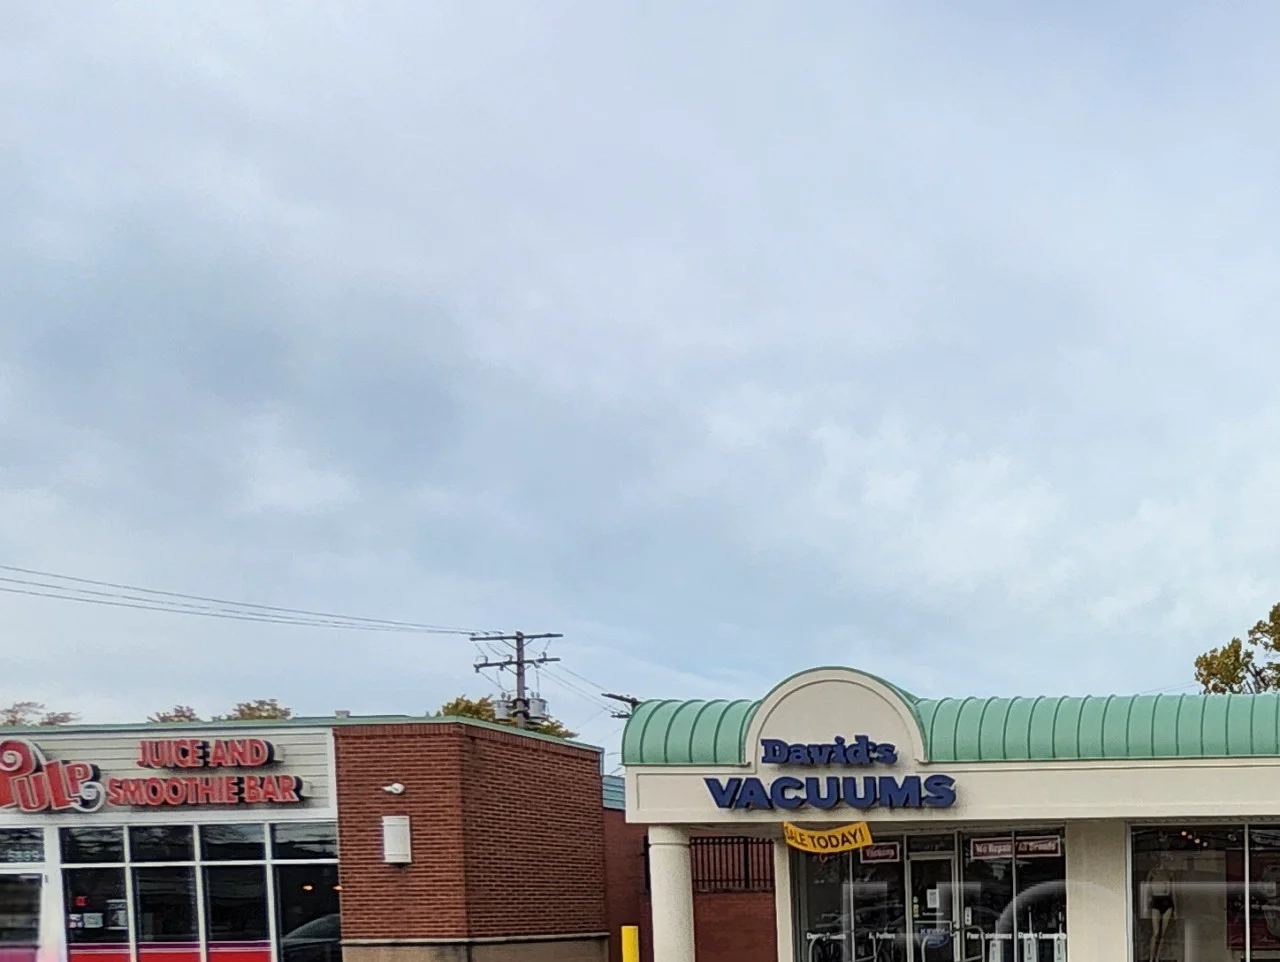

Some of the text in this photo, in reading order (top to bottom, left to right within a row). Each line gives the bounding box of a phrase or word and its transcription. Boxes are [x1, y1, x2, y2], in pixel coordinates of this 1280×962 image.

[136, 739, 268, 768] JUICE AND
[761, 735, 898, 765] David's
[107, 775, 299, 807] SMOOTHIE BAR
[704, 775, 957, 809] VACUUMS
[808, 826, 865, 849] TODAY!
